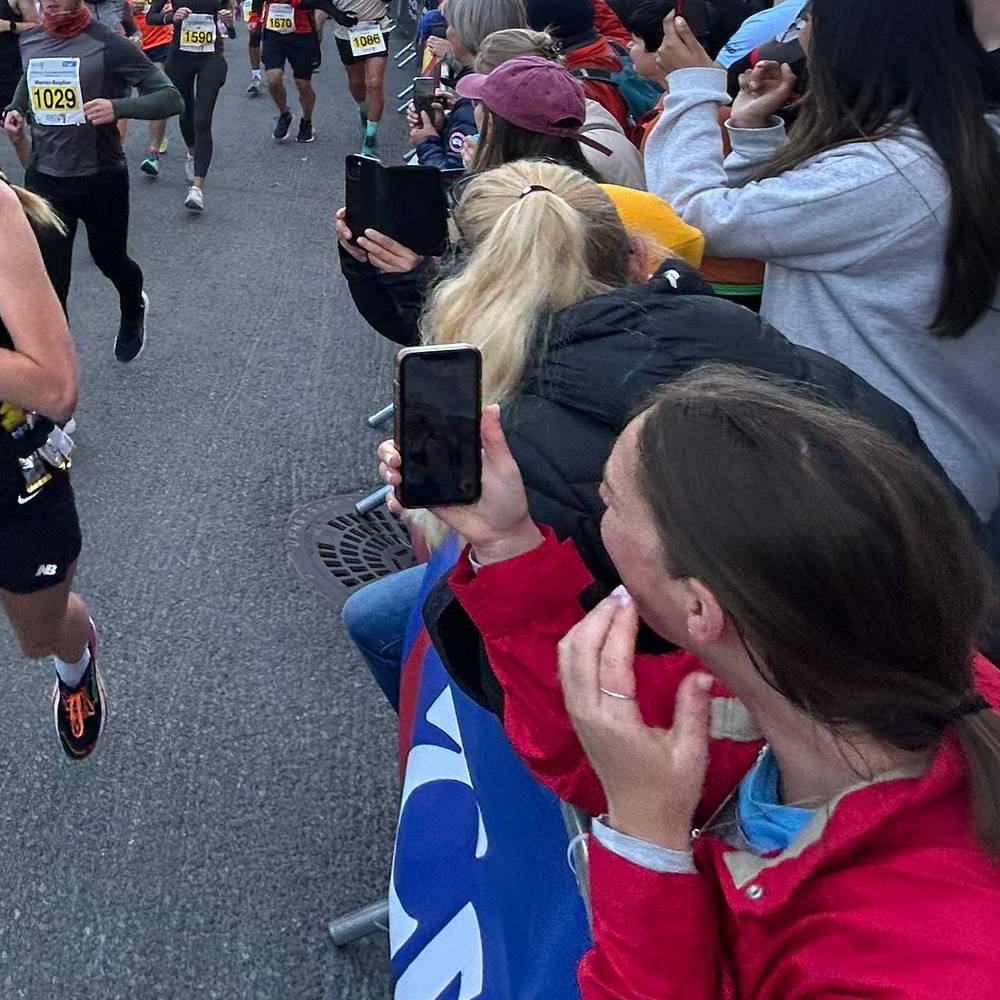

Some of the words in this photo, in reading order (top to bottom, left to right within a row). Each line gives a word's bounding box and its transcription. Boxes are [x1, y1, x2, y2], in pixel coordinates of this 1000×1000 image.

[184, 31, 213, 43] 1590
[353, 34, 381, 48] 1086
[34, 89, 76, 109] 1029
